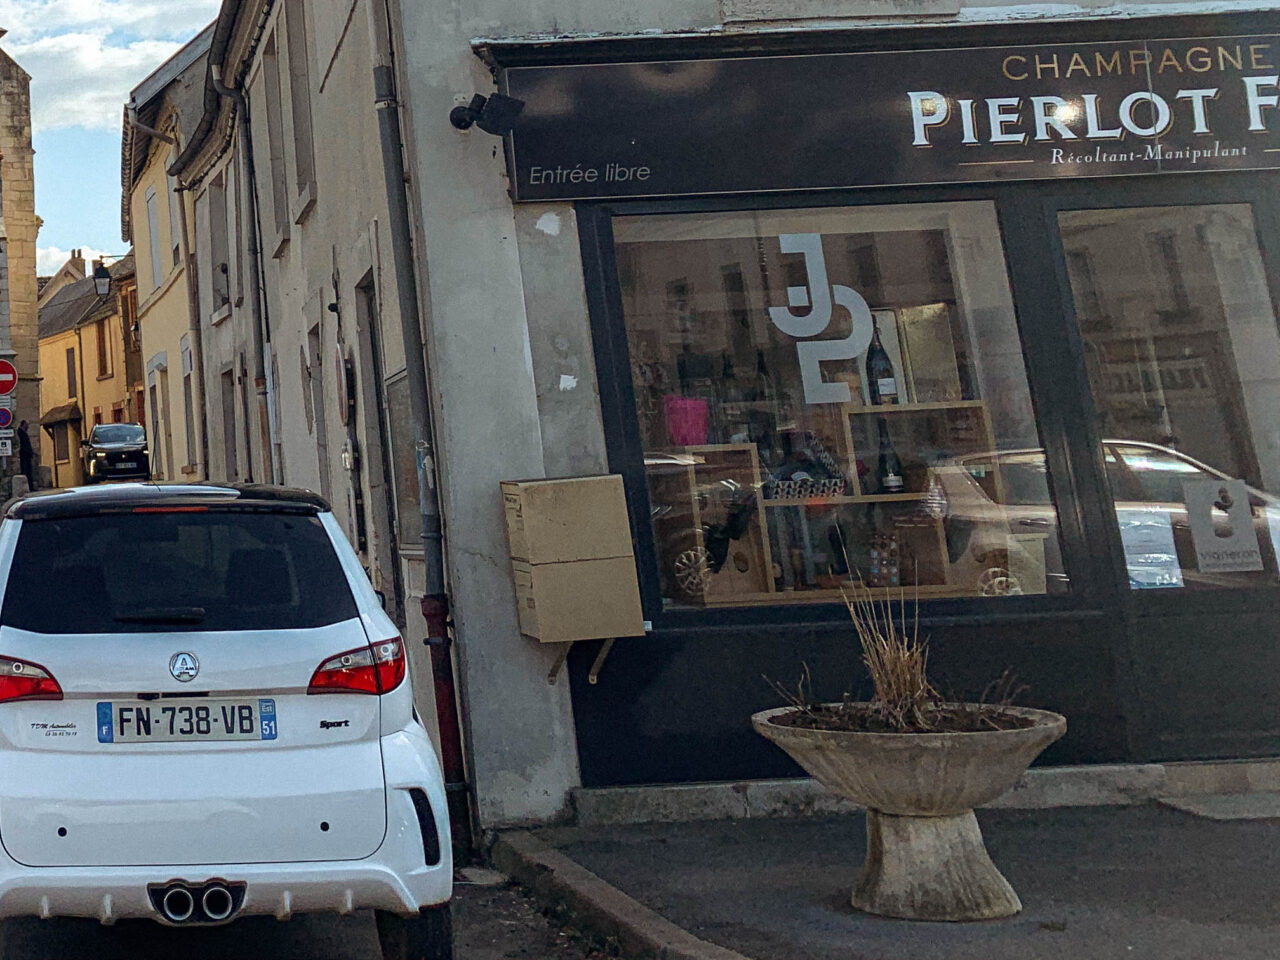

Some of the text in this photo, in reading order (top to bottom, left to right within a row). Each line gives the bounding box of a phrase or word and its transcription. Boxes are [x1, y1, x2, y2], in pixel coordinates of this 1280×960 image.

[1001, 44, 1275, 81] CHAMPAGNE
[906, 87, 1221, 147] PIERLOT
[1050, 141, 1248, 164] Récoltant-Manipulant
[529, 163, 651, 185] Entrée libre
[118, 705, 254, 737] FN-738-VB
[262, 720, 276, 736] 51
[319, 719, 350, 730] Sport
